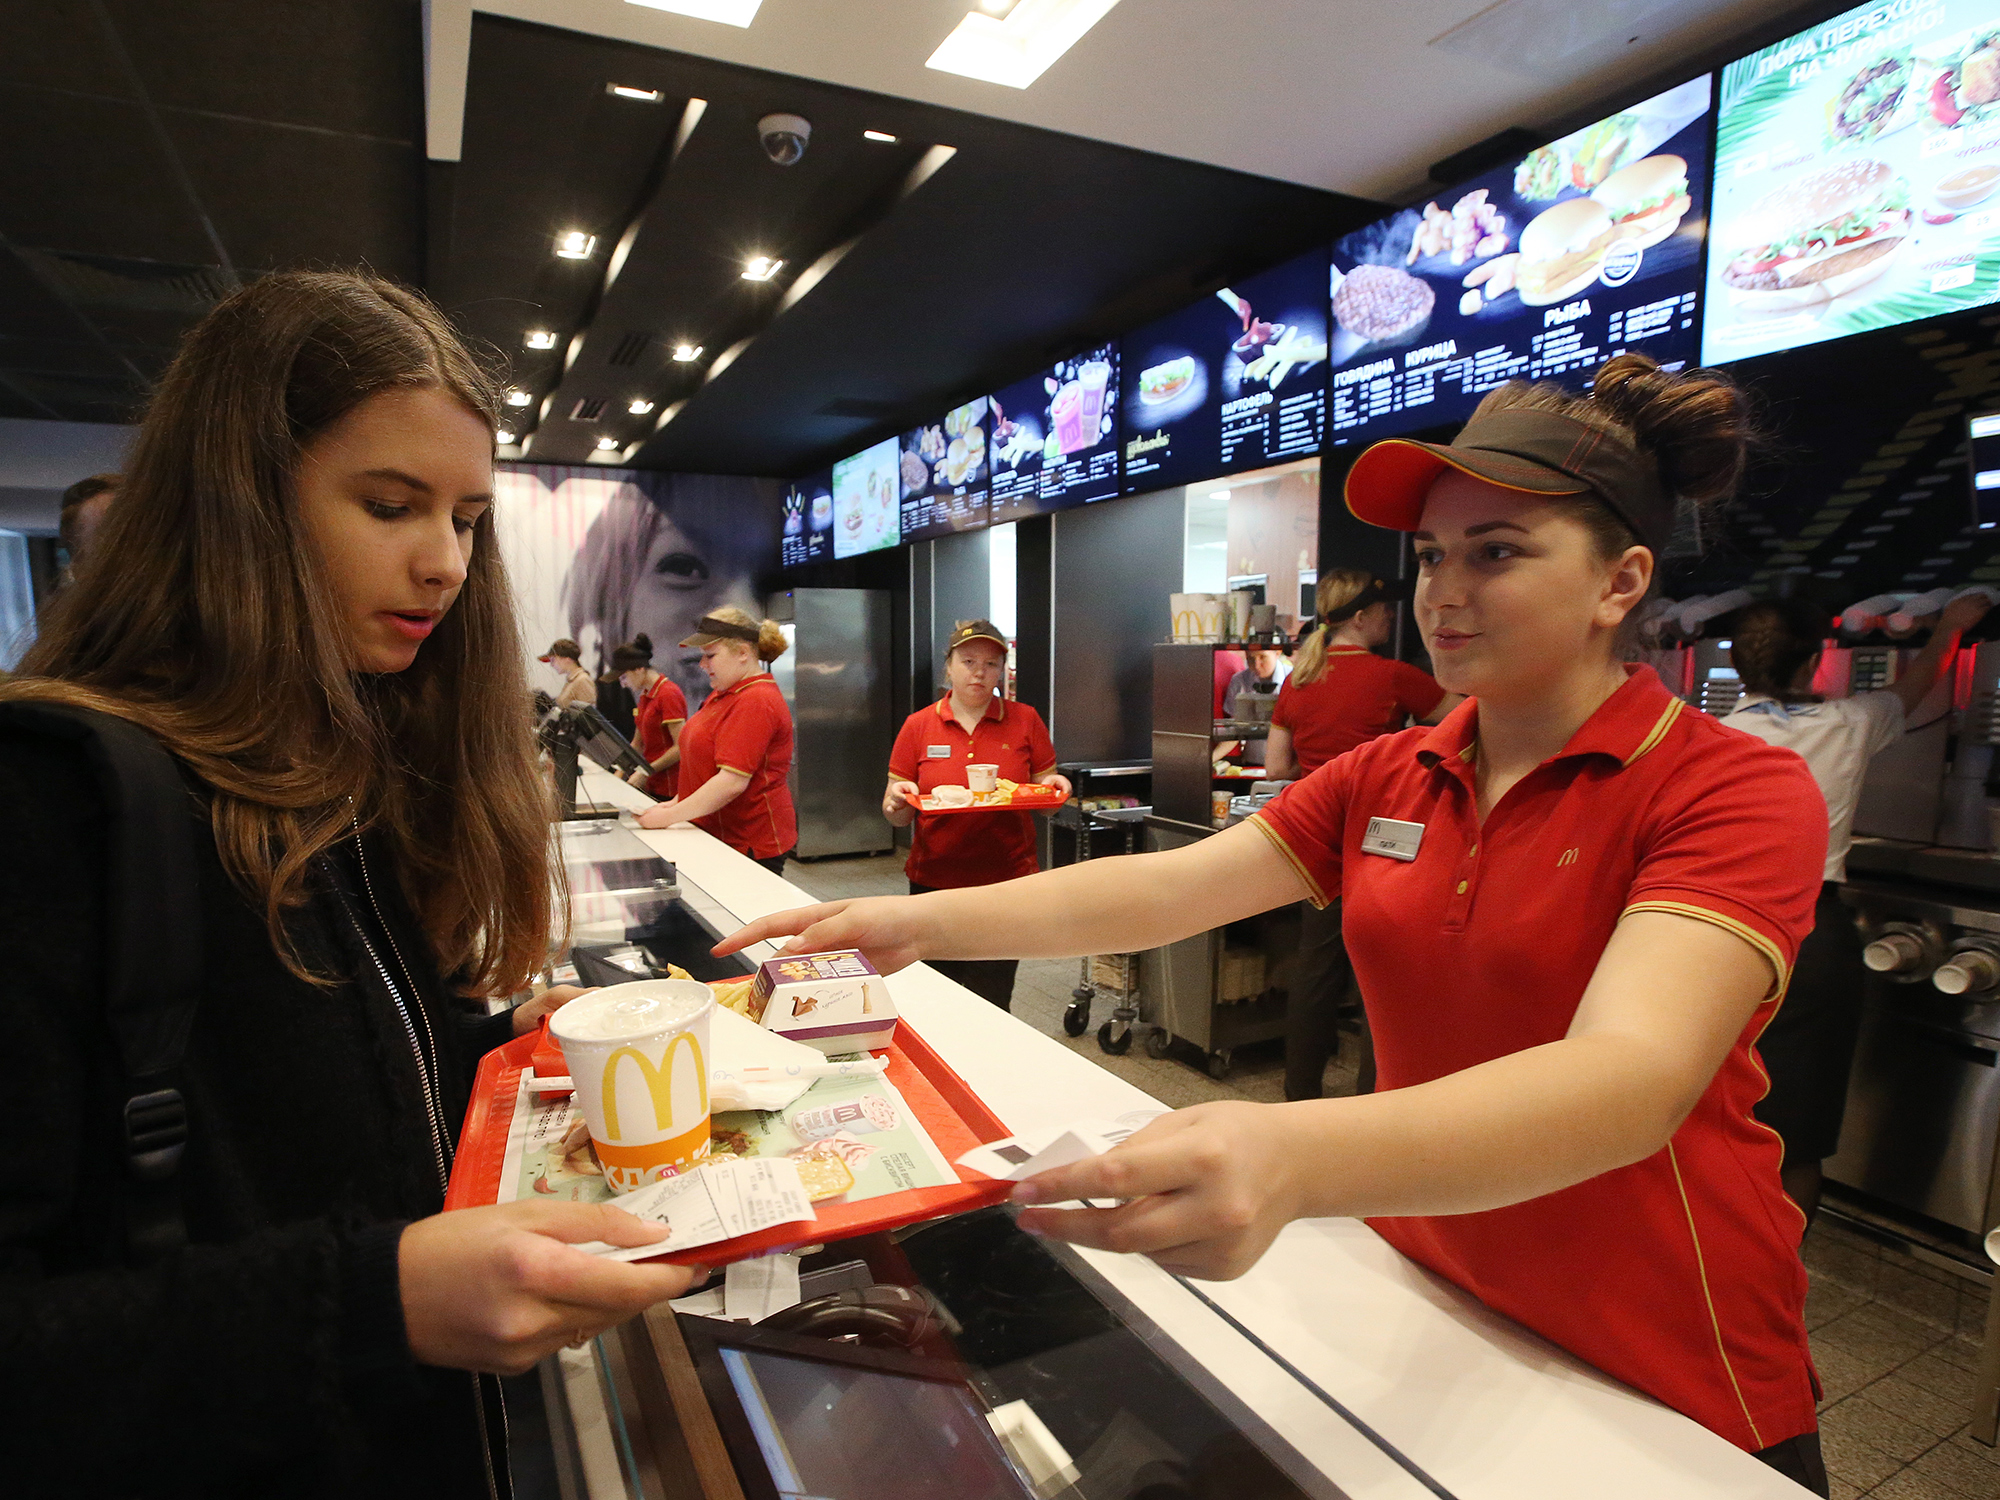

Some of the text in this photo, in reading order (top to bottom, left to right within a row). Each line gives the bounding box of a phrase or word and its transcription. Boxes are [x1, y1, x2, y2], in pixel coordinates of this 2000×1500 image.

[1758, 38, 1817, 79] ПОРА
[1789, 58, 1823, 88] НА
[1543, 298, 1592, 328] РЫБА
[1404, 339, 1458, 369] КУРИЦА
[1333, 357, 1396, 389] ГОВЯДИНА
[1220, 390, 1274, 417] КАРТОФЕЛЬ
